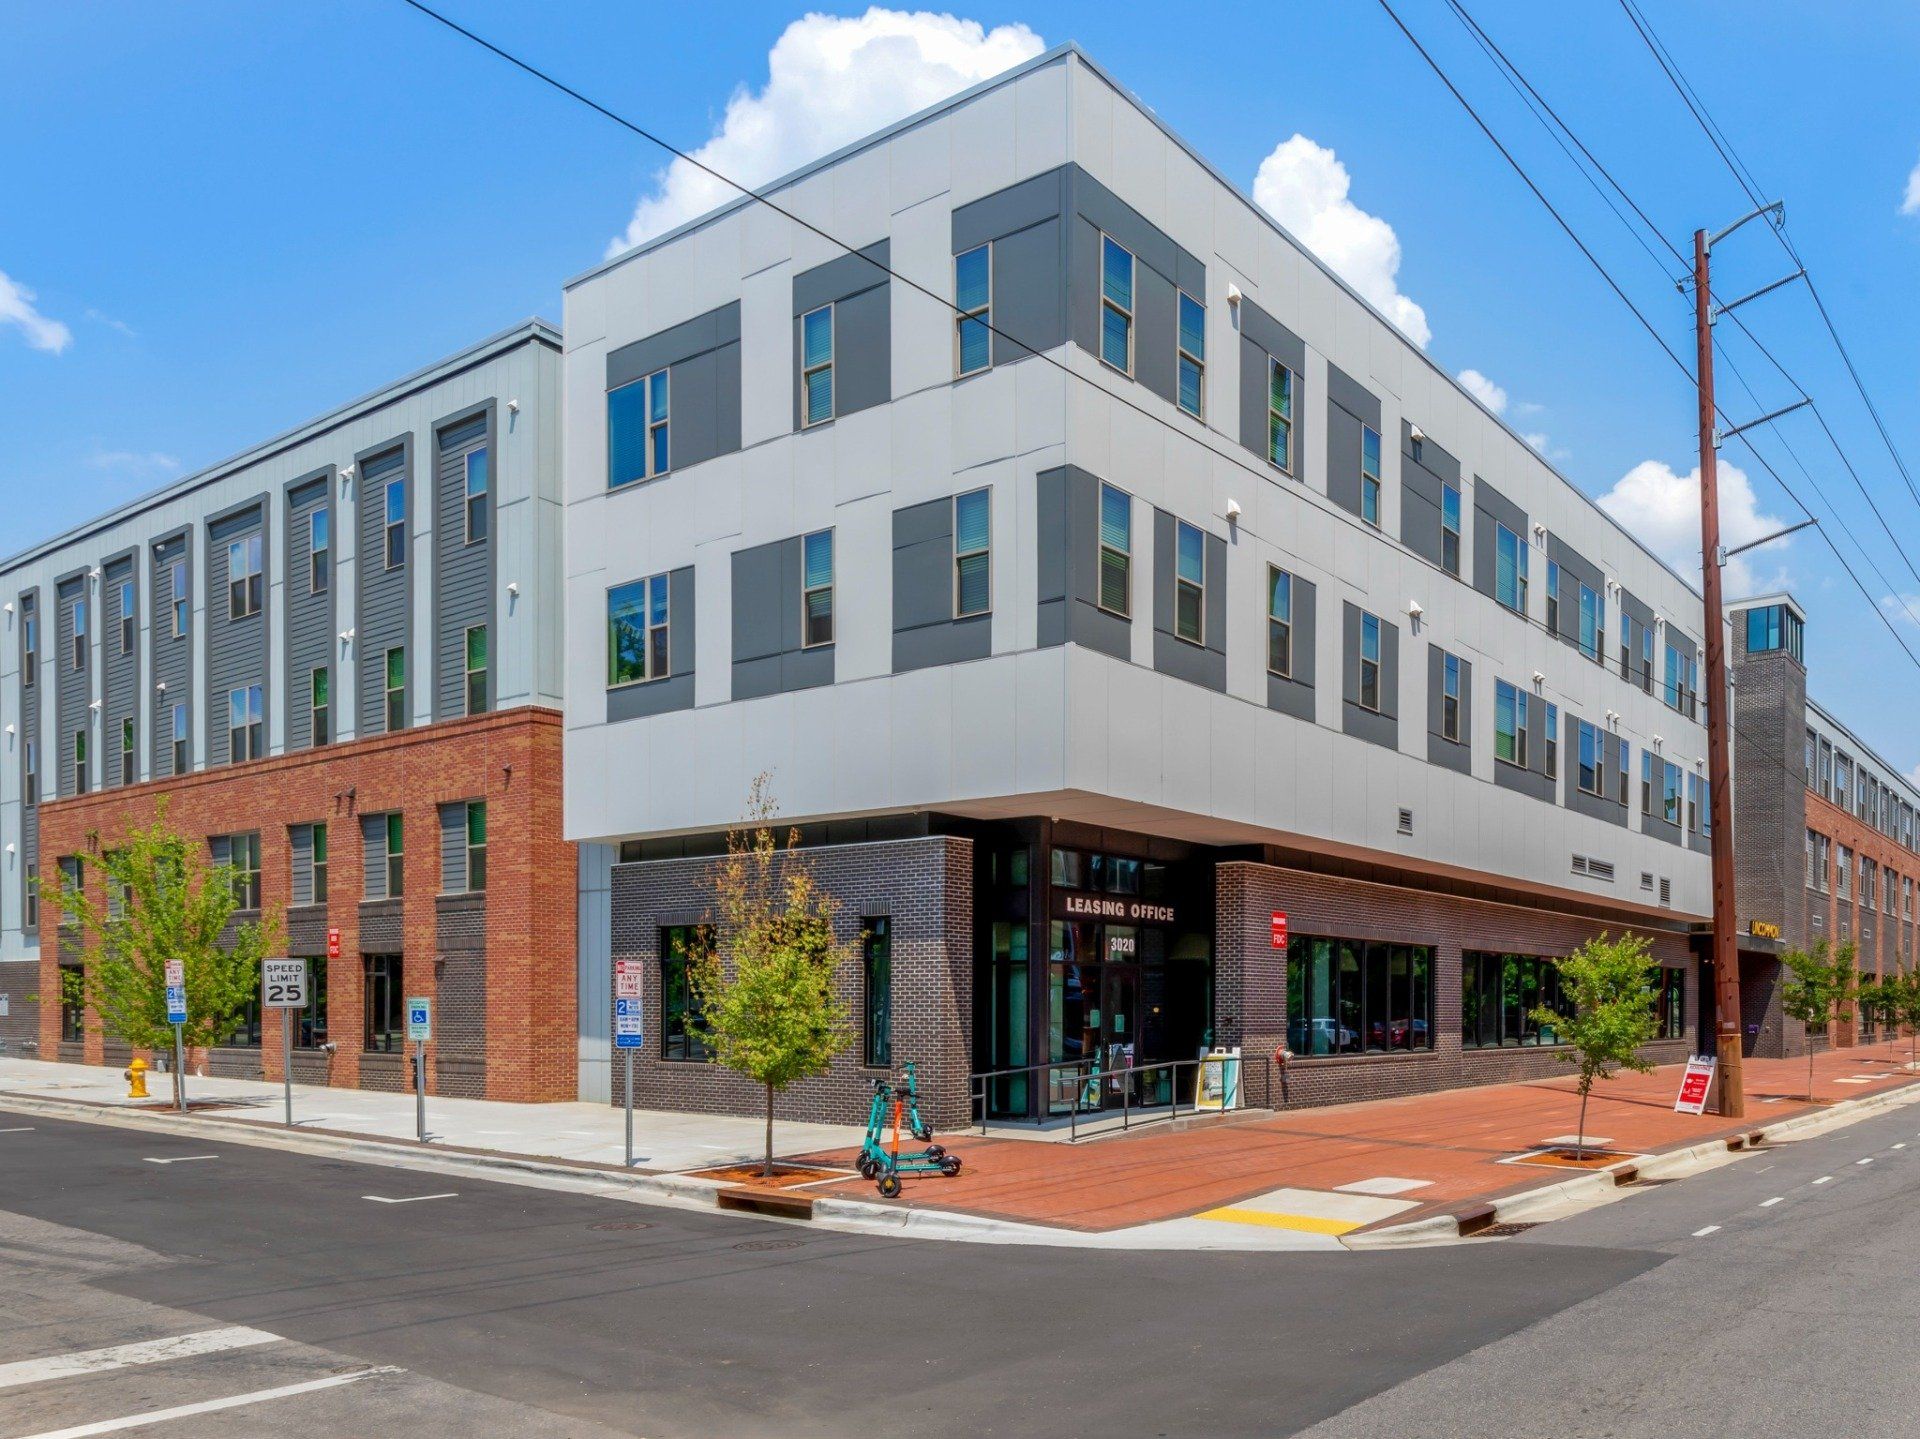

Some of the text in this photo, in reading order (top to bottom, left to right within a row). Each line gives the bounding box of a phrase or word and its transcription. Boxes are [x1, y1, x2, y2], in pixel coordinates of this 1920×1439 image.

[1066, 897, 1175, 922] LEASING OFFICE
[1110, 937, 1135, 953] 3020
[1273, 933, 1285, 945] FDC
[266, 964, 303, 972] SPEED
[270, 974, 299, 982] LIMIT
[620, 982, 639, 991] TIME
[168, 988, 174, 998] 2
[268, 984, 302, 1002] 25
[618, 1001, 626, 1014] 2
